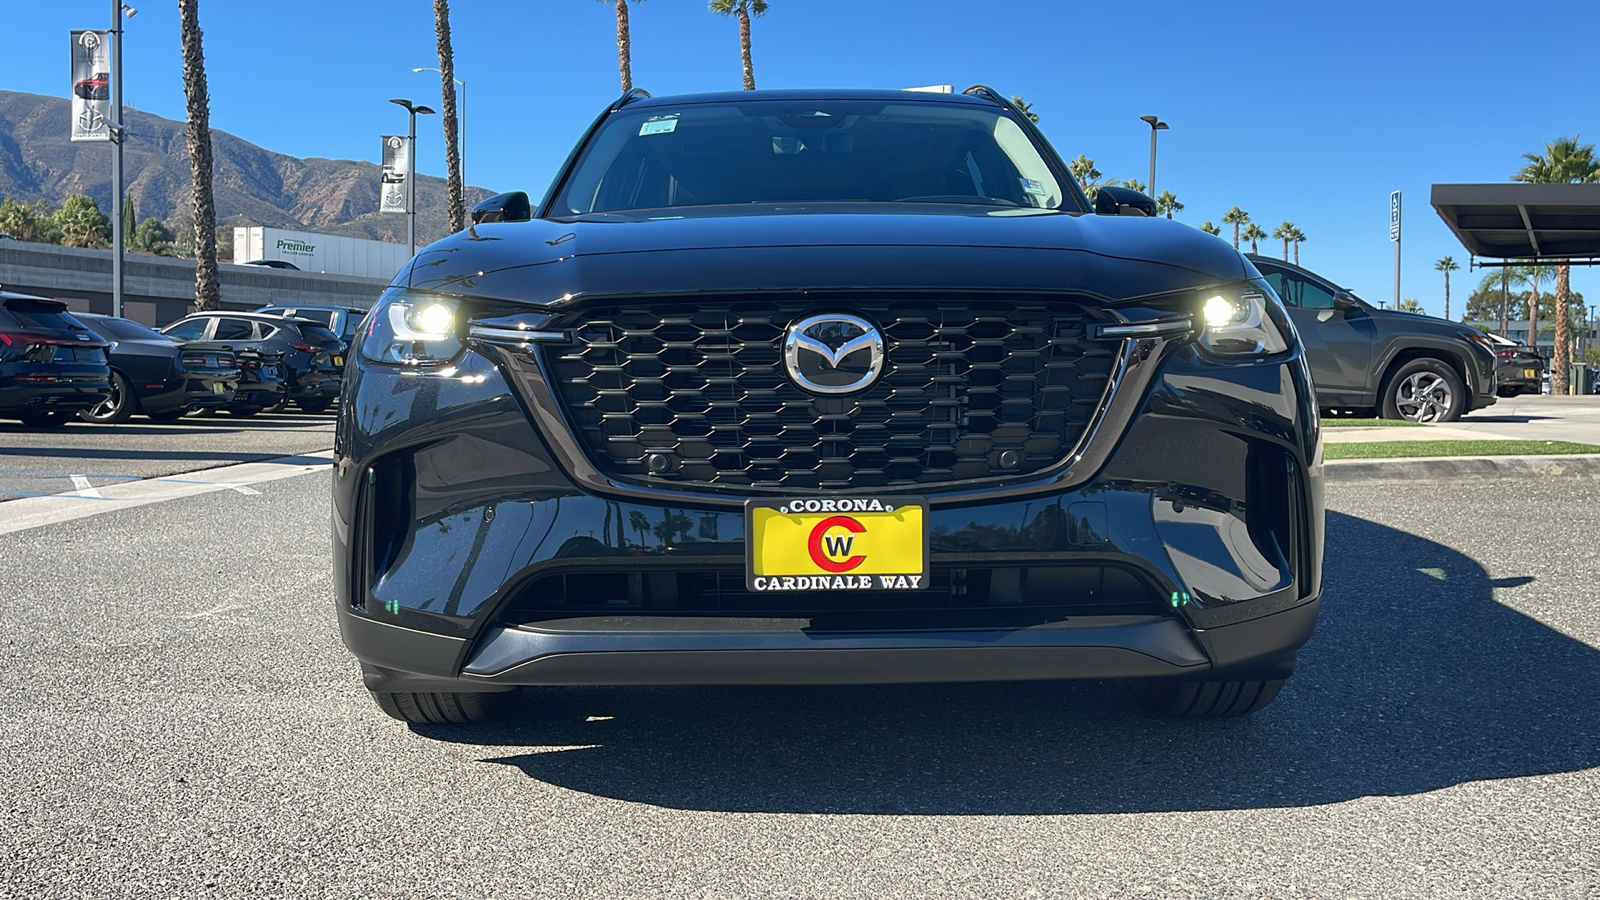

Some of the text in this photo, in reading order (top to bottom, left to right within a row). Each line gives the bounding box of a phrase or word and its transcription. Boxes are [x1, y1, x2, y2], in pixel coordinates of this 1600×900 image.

[277, 240, 316, 253] Premier
[789, 499, 884, 512] CORONA
[807, 515, 868, 573] C
[825, 533, 855, 557] W
[754, 576, 922, 590] CARDINALE WAY
